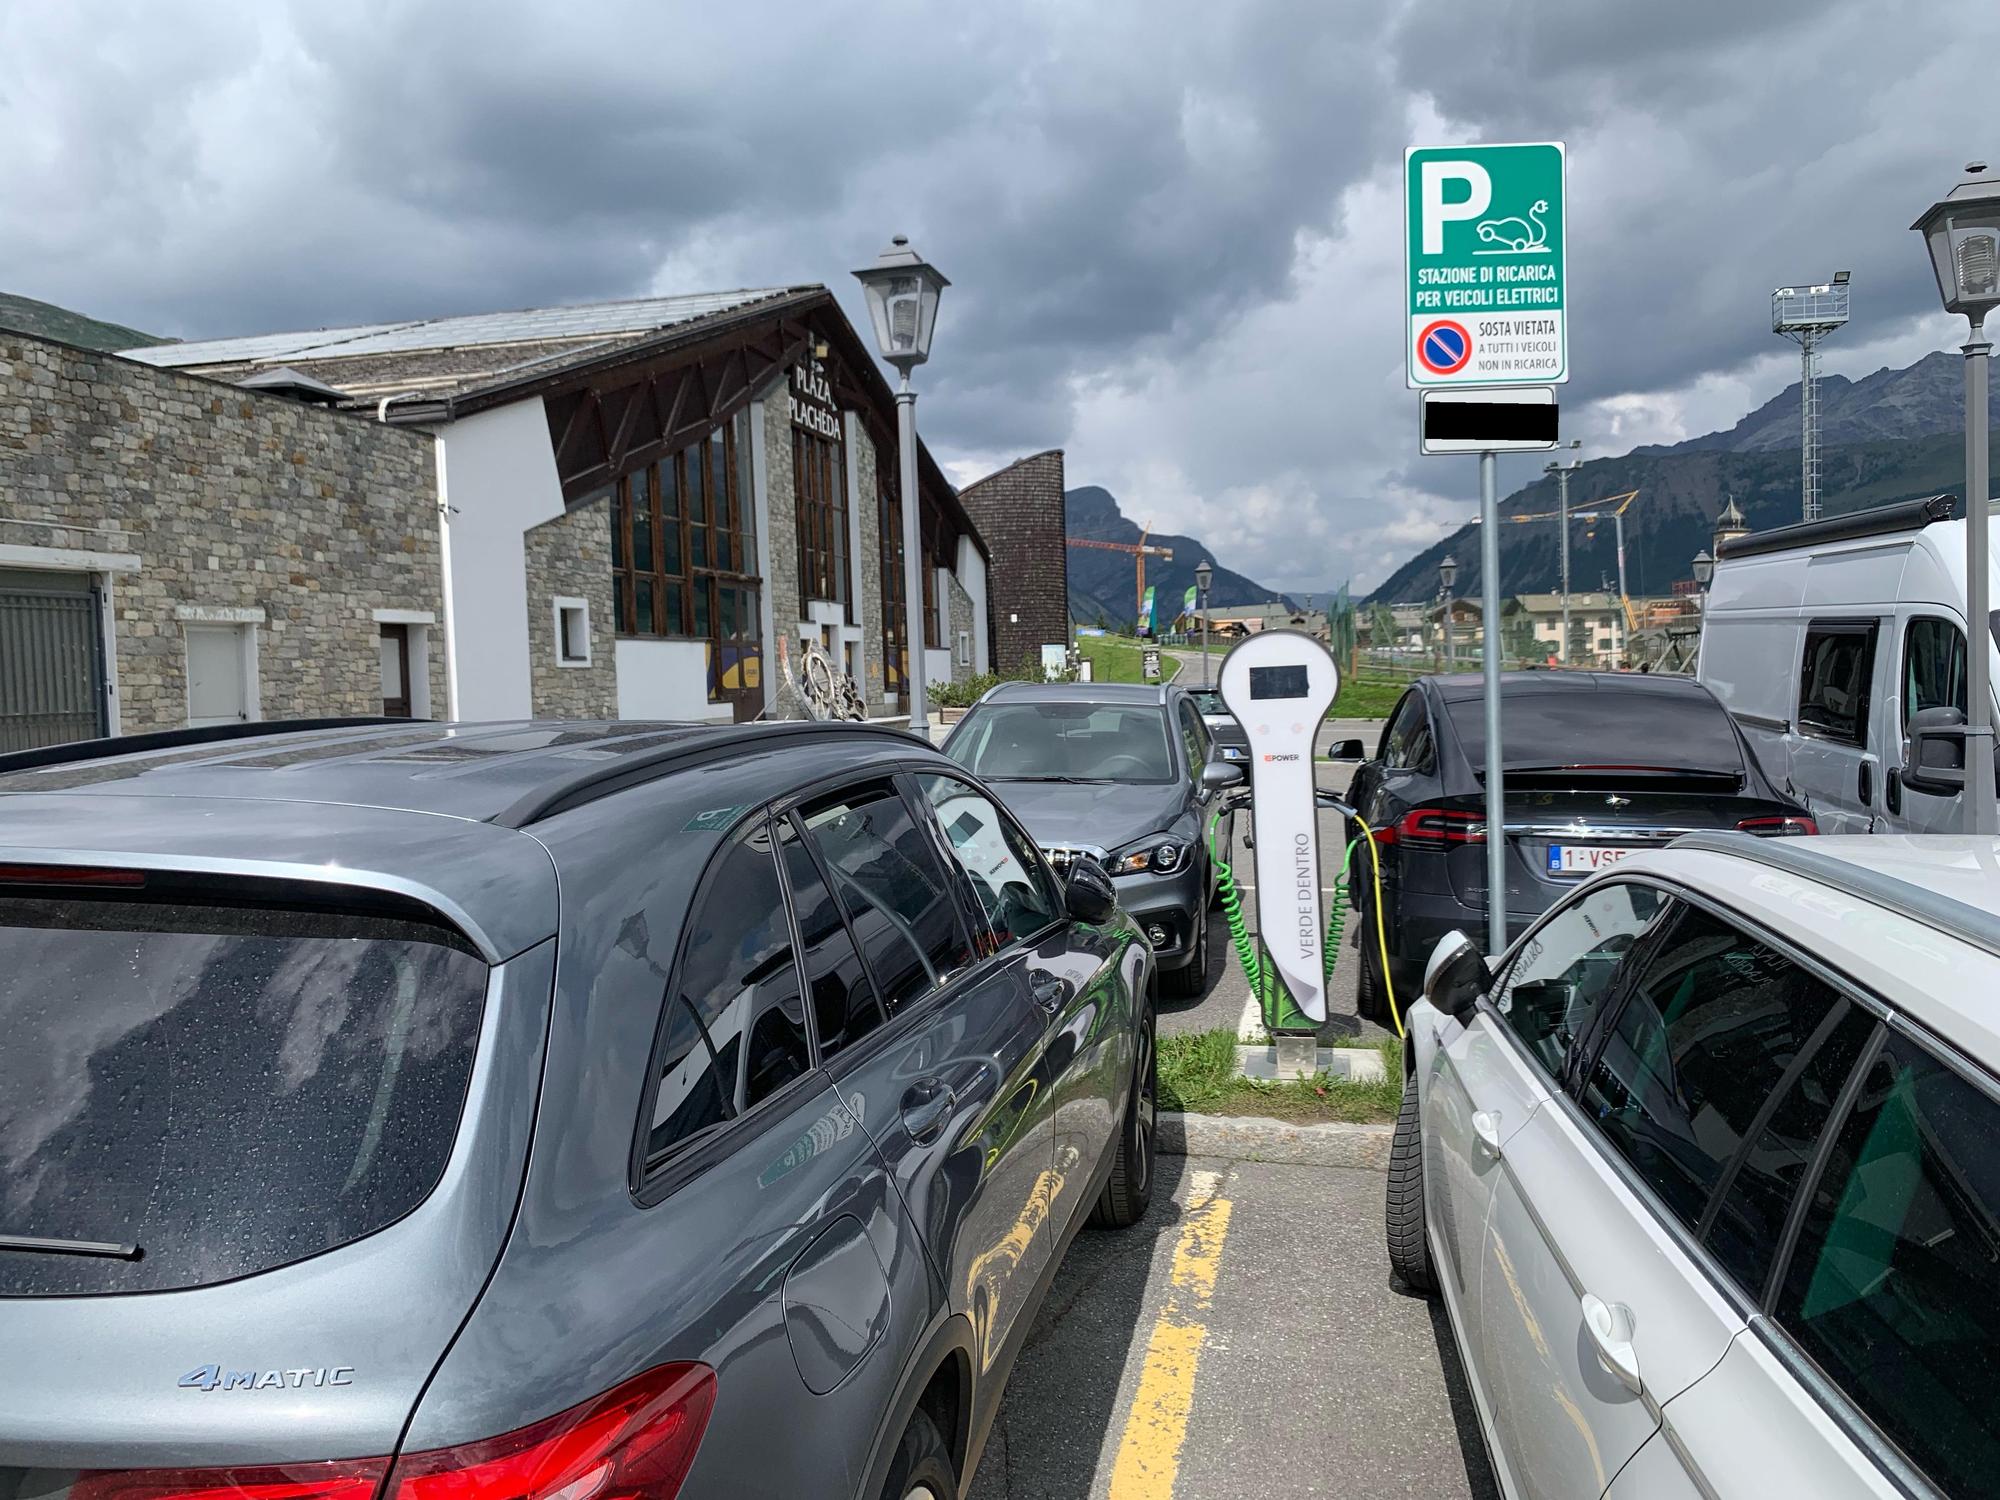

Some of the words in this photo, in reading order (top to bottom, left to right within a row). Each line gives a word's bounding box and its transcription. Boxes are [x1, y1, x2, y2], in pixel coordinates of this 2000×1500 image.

[1421, 160, 1492, 255] P
[1418, 266, 1477, 285] STAZIONE
[1480, 266, 1493, 283] DI
[1496, 264, 1556, 282] RICARICA
[1416, 290, 1441, 308] PER
[1443, 288, 1493, 306] VEICOLI
[1496, 286, 1558, 304] ELETTRICI
[1479, 321, 1511, 337] SOSTA
[1513, 320, 1556, 336] VIETATA
[1478, 344, 1485, 354] A
[1487, 342, 1513, 353] TUTTI
[1521, 341, 1556, 352] VEICOLI
[1478, 360, 1498, 371] NON
[1501, 360, 1511, 370] IN
[1513, 358, 1557, 370] RICARICA
[1294, 833, 1312, 901] DENTRO
[1551, 860, 1560, 869] B
[1298, 906, 1315, 960] VERDE
[178, 1364, 355, 1391] 4MATIC
